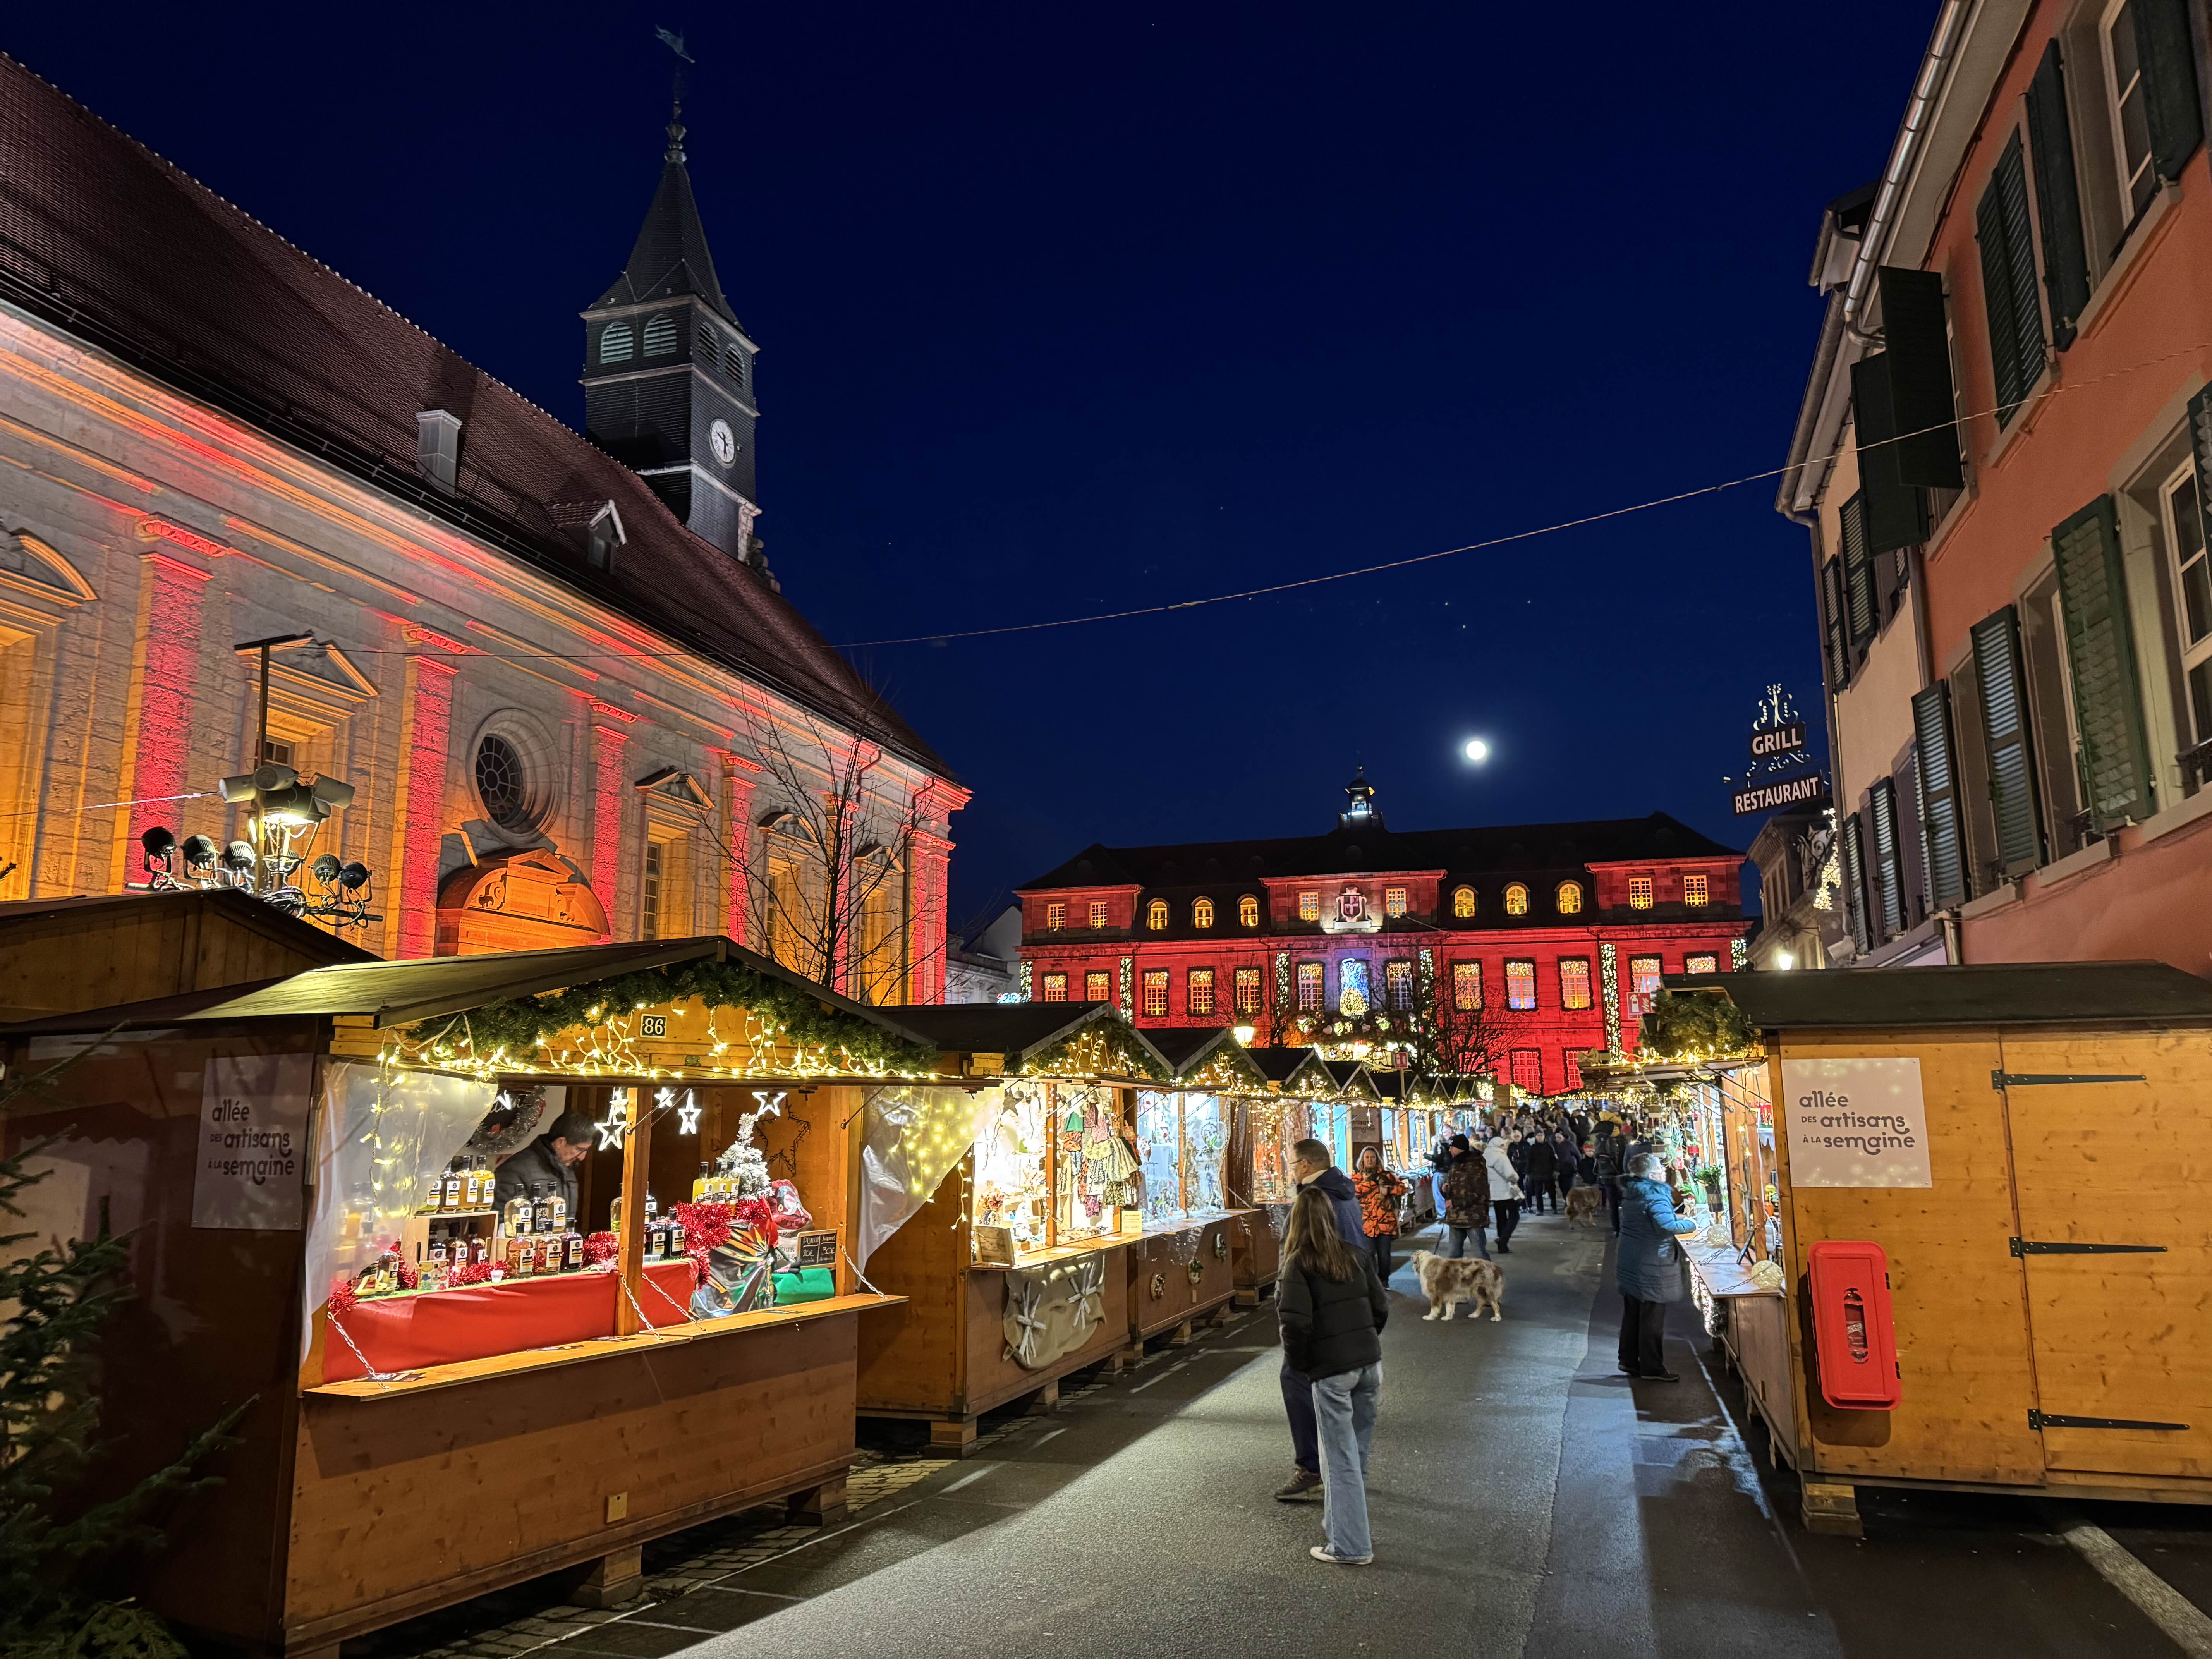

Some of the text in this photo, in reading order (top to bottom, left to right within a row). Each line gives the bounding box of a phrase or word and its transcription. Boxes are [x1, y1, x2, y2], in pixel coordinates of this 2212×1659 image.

[1752, 728, 1802, 754] GRILL
[1735, 777, 1818, 814] RESTAURANT
[644, 1018, 663, 1034] 86
[212, 1099, 249, 1121] allée
[1799, 1090, 1849, 1107] allée
[1820, 1112, 1910, 1135] artisans
[210, 1128, 292, 1158] DES artisans
[1803, 1134, 1808, 1143] À
[1823, 1132, 1915, 1156] semaine
[207, 1158, 211, 1169] À
[223, 1154, 294, 1185] semaine
